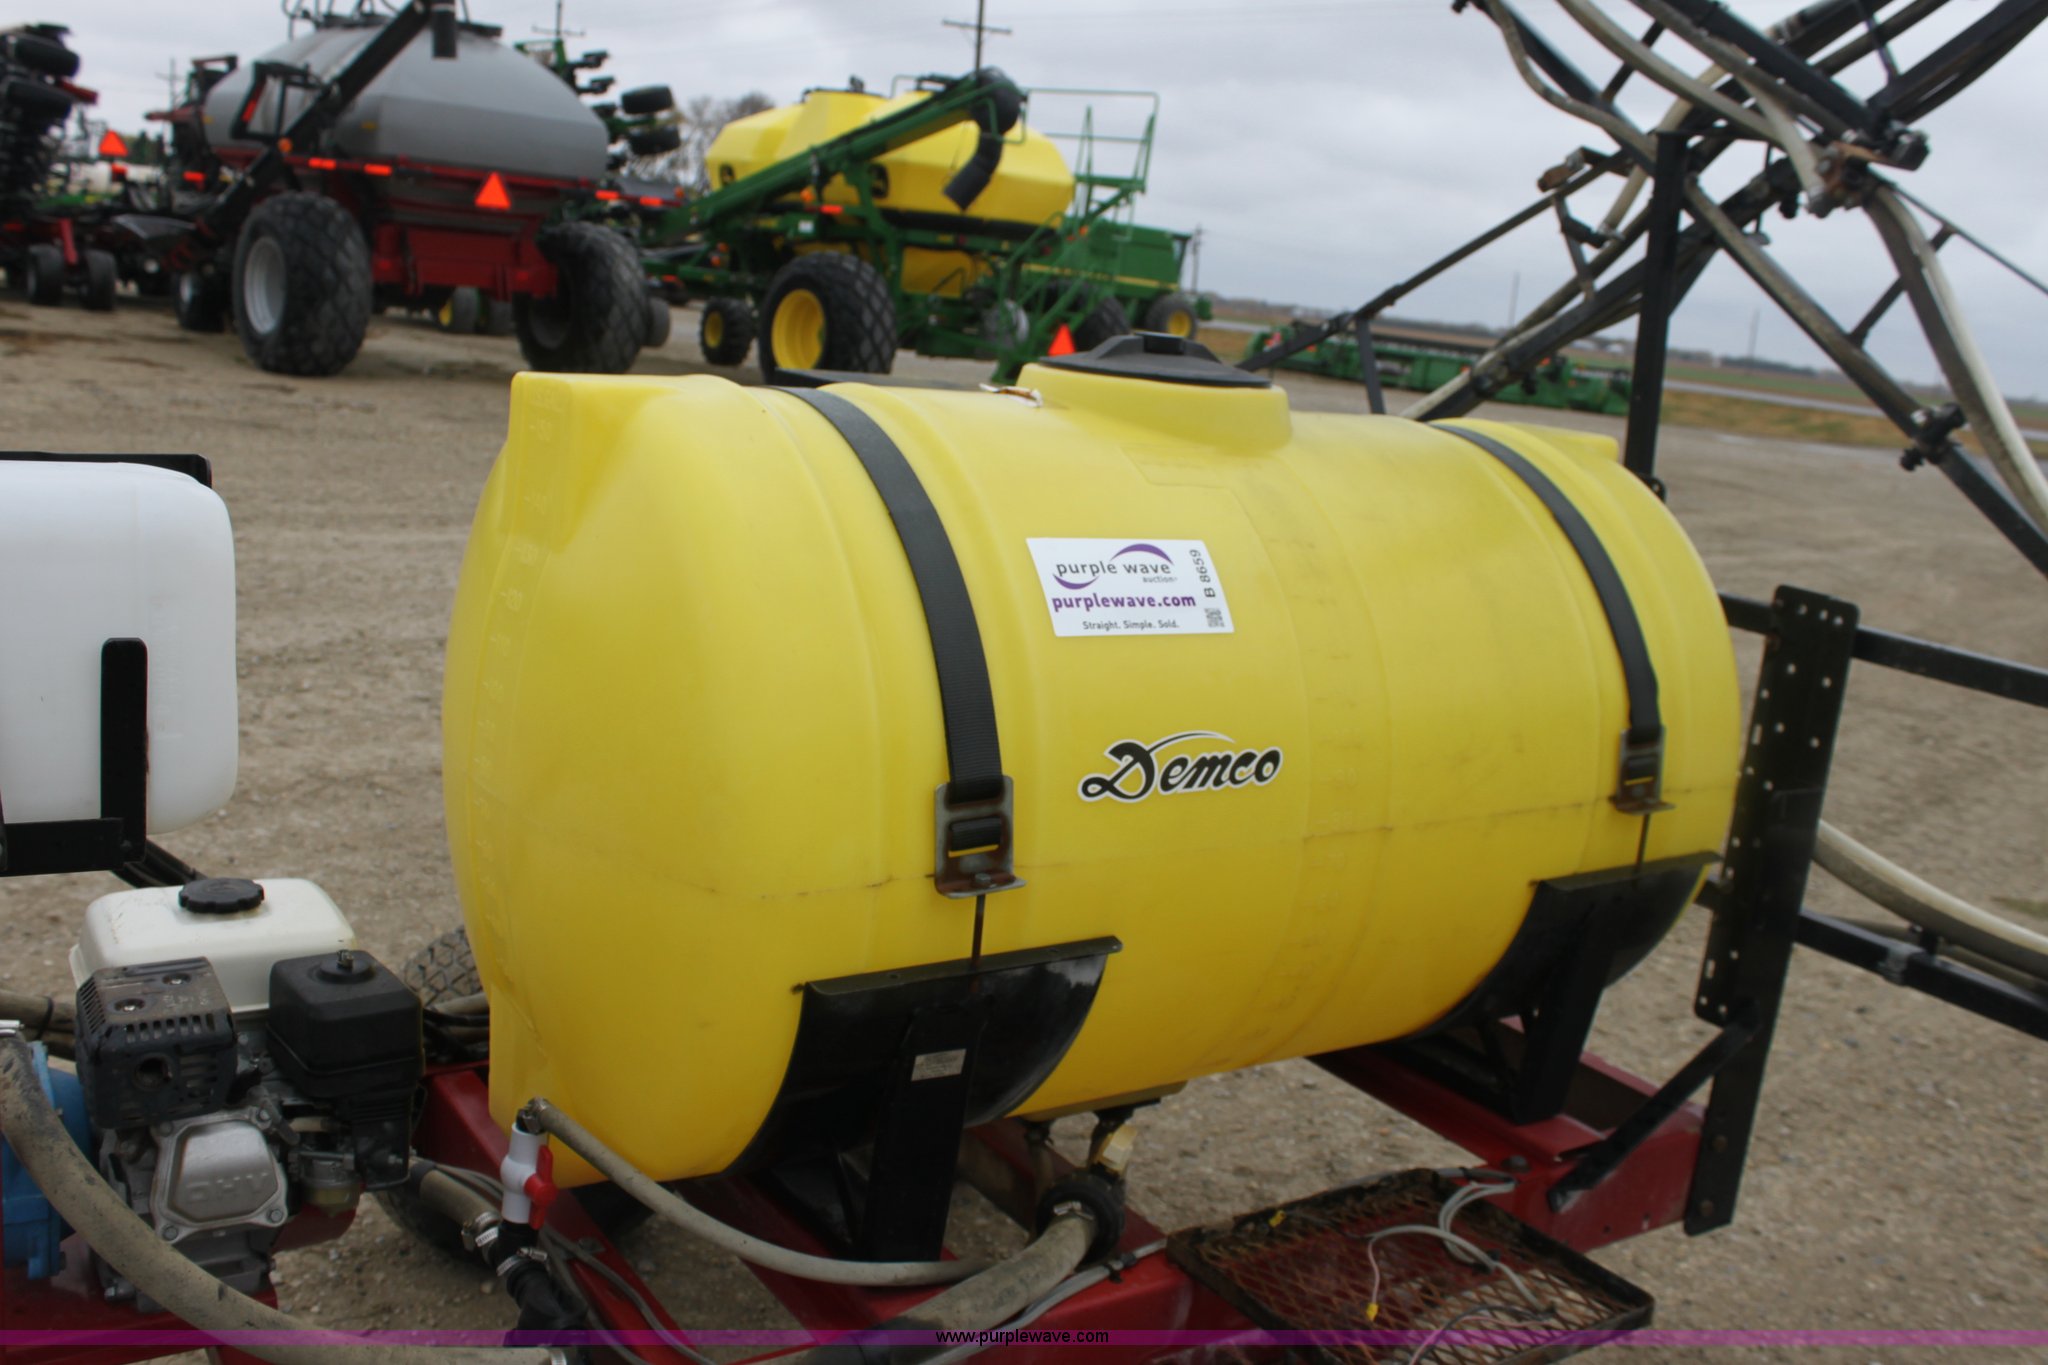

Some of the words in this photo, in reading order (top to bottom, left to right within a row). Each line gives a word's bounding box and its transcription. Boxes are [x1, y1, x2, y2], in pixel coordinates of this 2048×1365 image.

[1056, 561, 1118, 577] purple
[1123, 563, 1171, 575] wave
[1189, 549, 1211, 583] 8659
[1204, 587, 1216, 598] B
[1051, 592, 1197, 612] purplewave.com
[1082, 620, 1122, 631] Straight.
[1123, 620, 1156, 631] Simple.
[1158, 619, 1180, 629] Sold.
[1079, 730, 1283, 803] Demco
